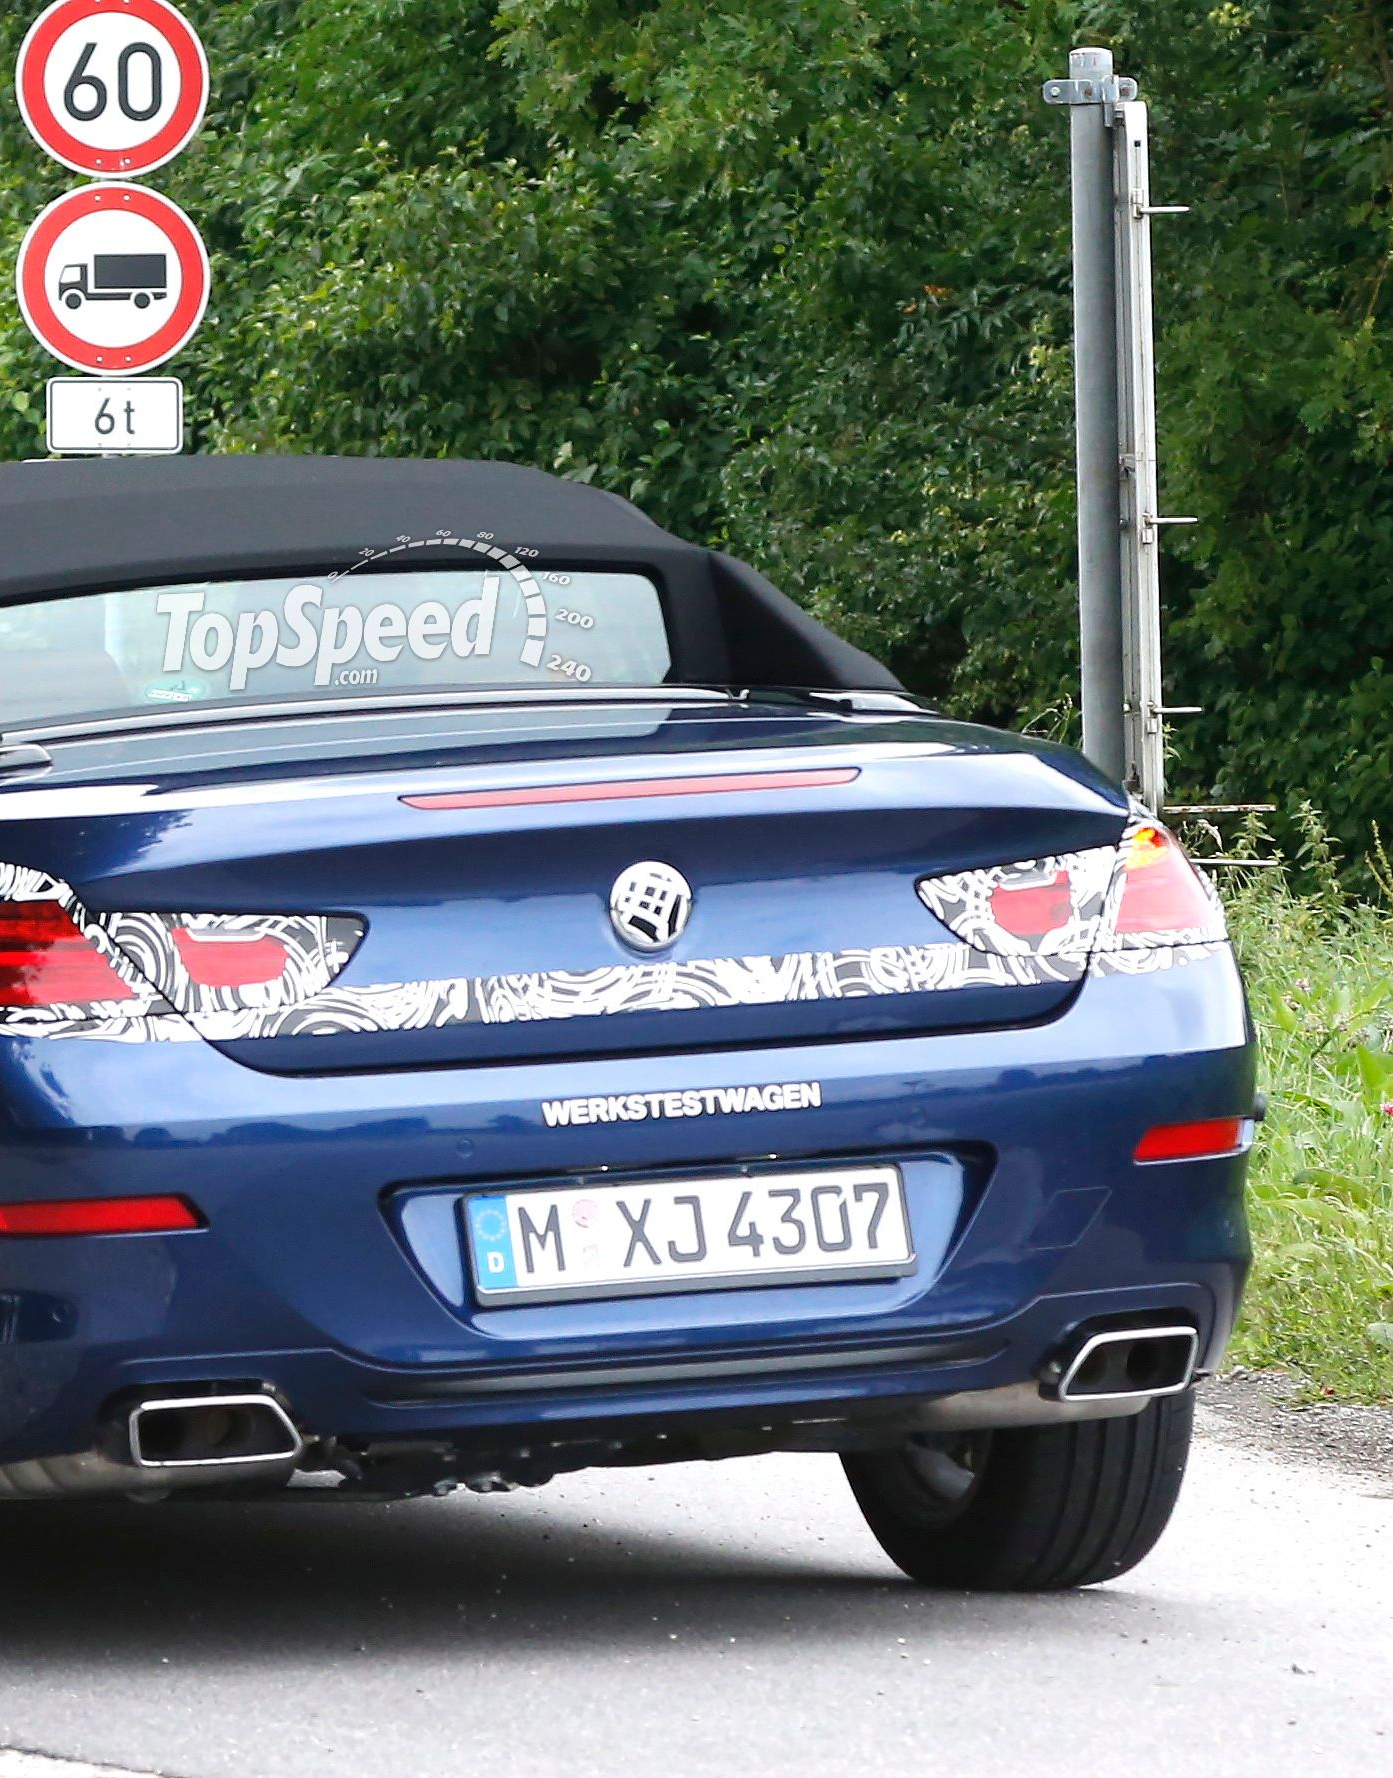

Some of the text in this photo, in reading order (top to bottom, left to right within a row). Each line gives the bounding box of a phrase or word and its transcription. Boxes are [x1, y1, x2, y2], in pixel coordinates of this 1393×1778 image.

[63, 41, 162, 122] 60
[542, 1081, 823, 1128] WERKSTESTWAGEN
[518, 1182, 890, 1274] M XJ 4307
[487, 1251, 505, 1273] D
